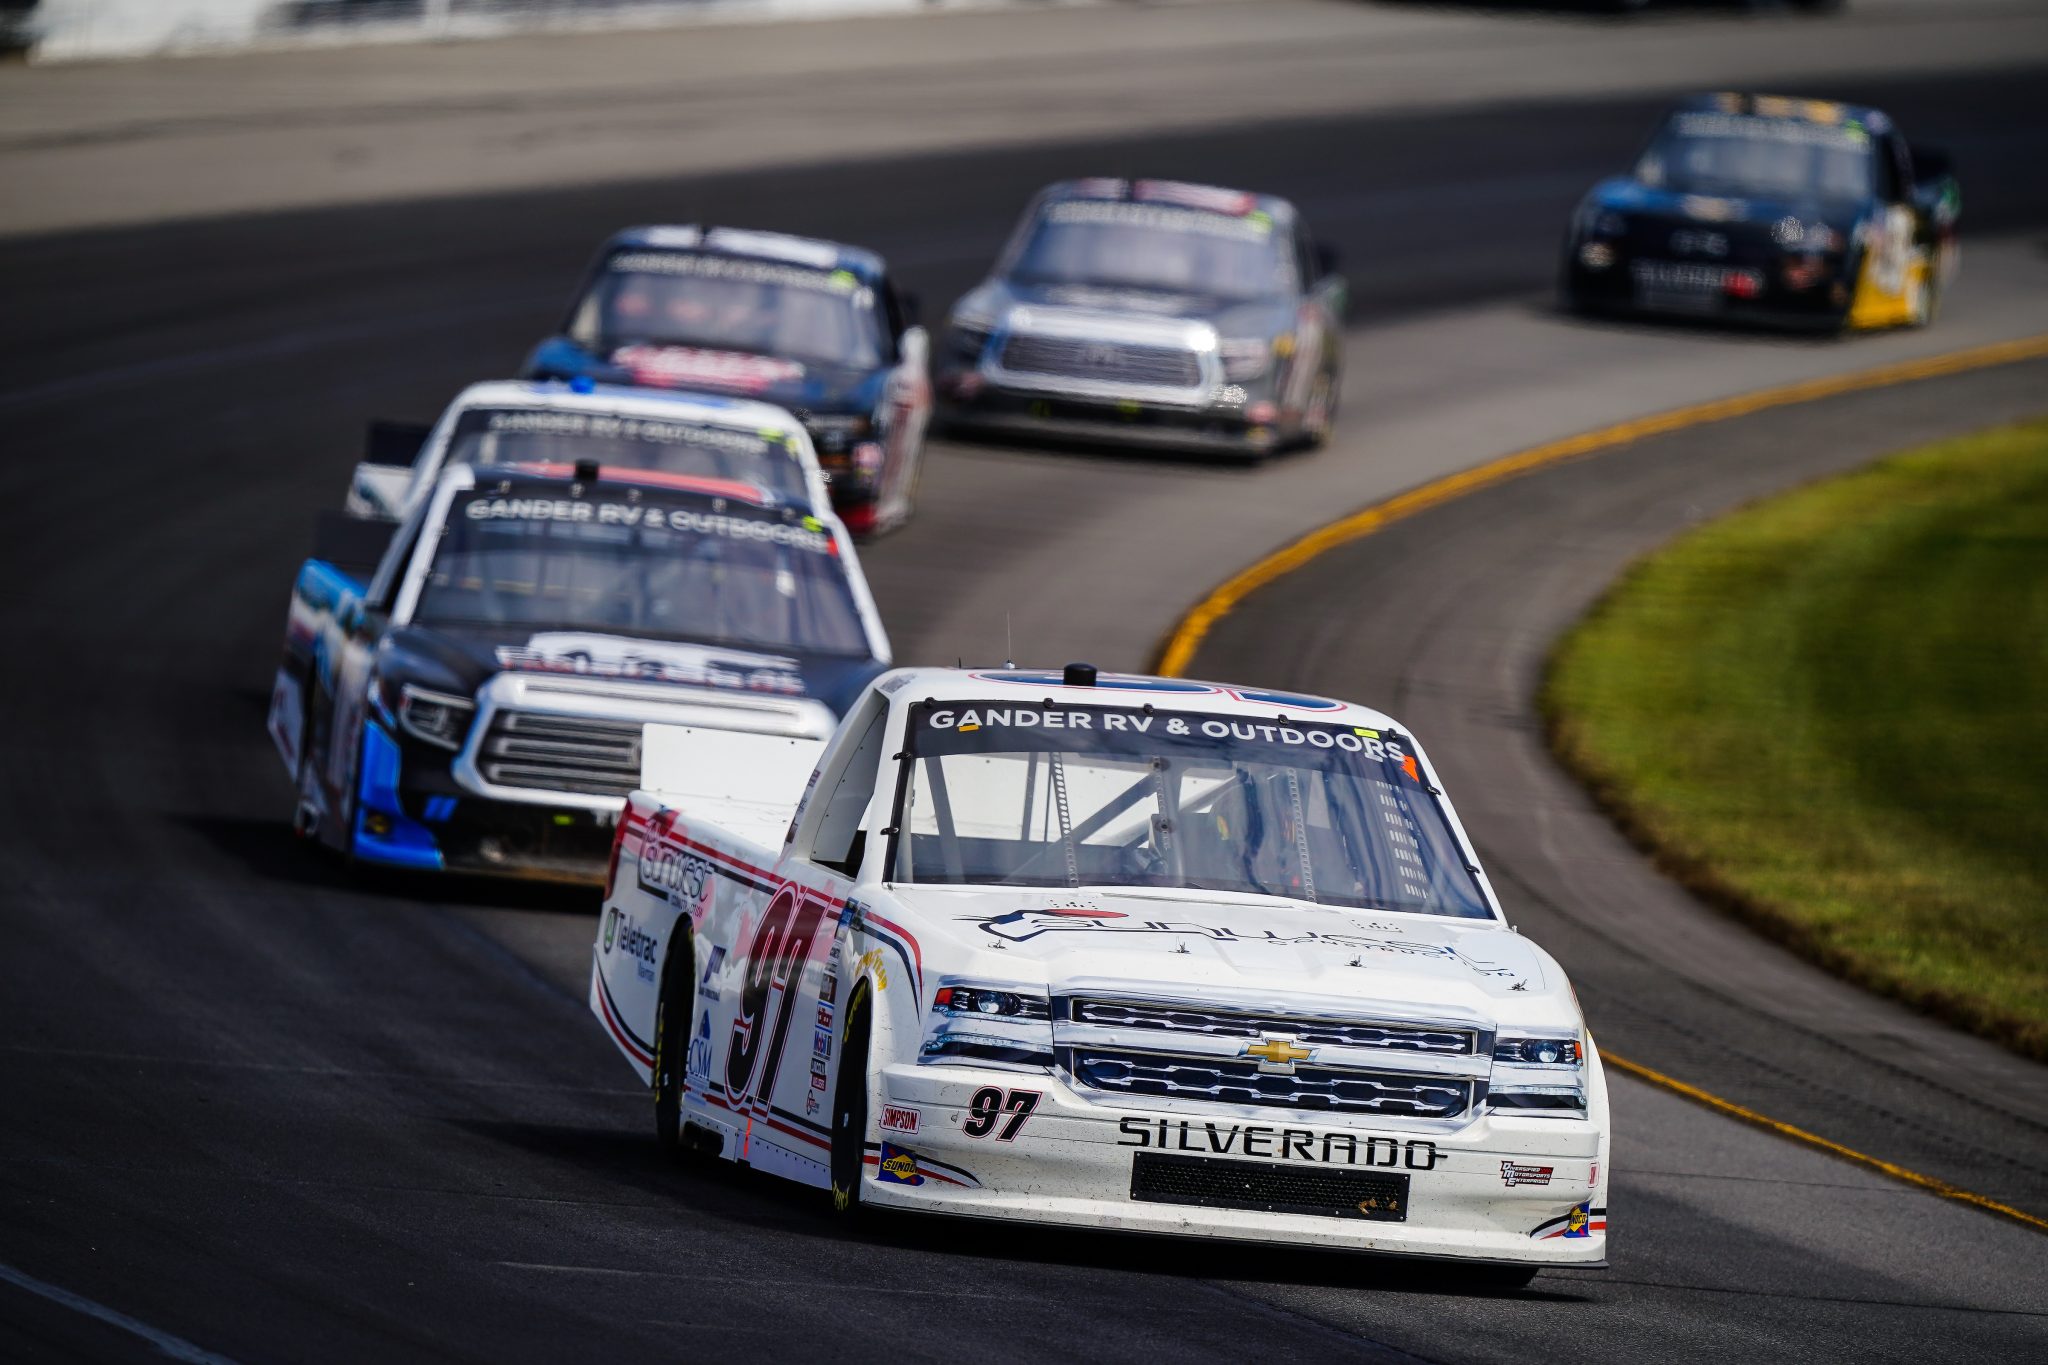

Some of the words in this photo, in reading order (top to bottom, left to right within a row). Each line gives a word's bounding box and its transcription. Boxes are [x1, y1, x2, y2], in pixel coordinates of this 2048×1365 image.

[465, 499, 593, 522] GANDER
[598, 502, 643, 526] RV
[643, 507, 665, 529] &
[929, 708, 1093, 730] GANDER
[1104, 712, 1154, 733] RV
[1165, 718, 1191, 736] &
[1201, 720, 1405, 763] OUTDOORS
[724, 880, 835, 1124] 97
[882, 1107, 918, 1131] SIMPSON
[962, 1085, 1043, 1143] 97
[1117, 1116, 1438, 1171] SILVERADO
